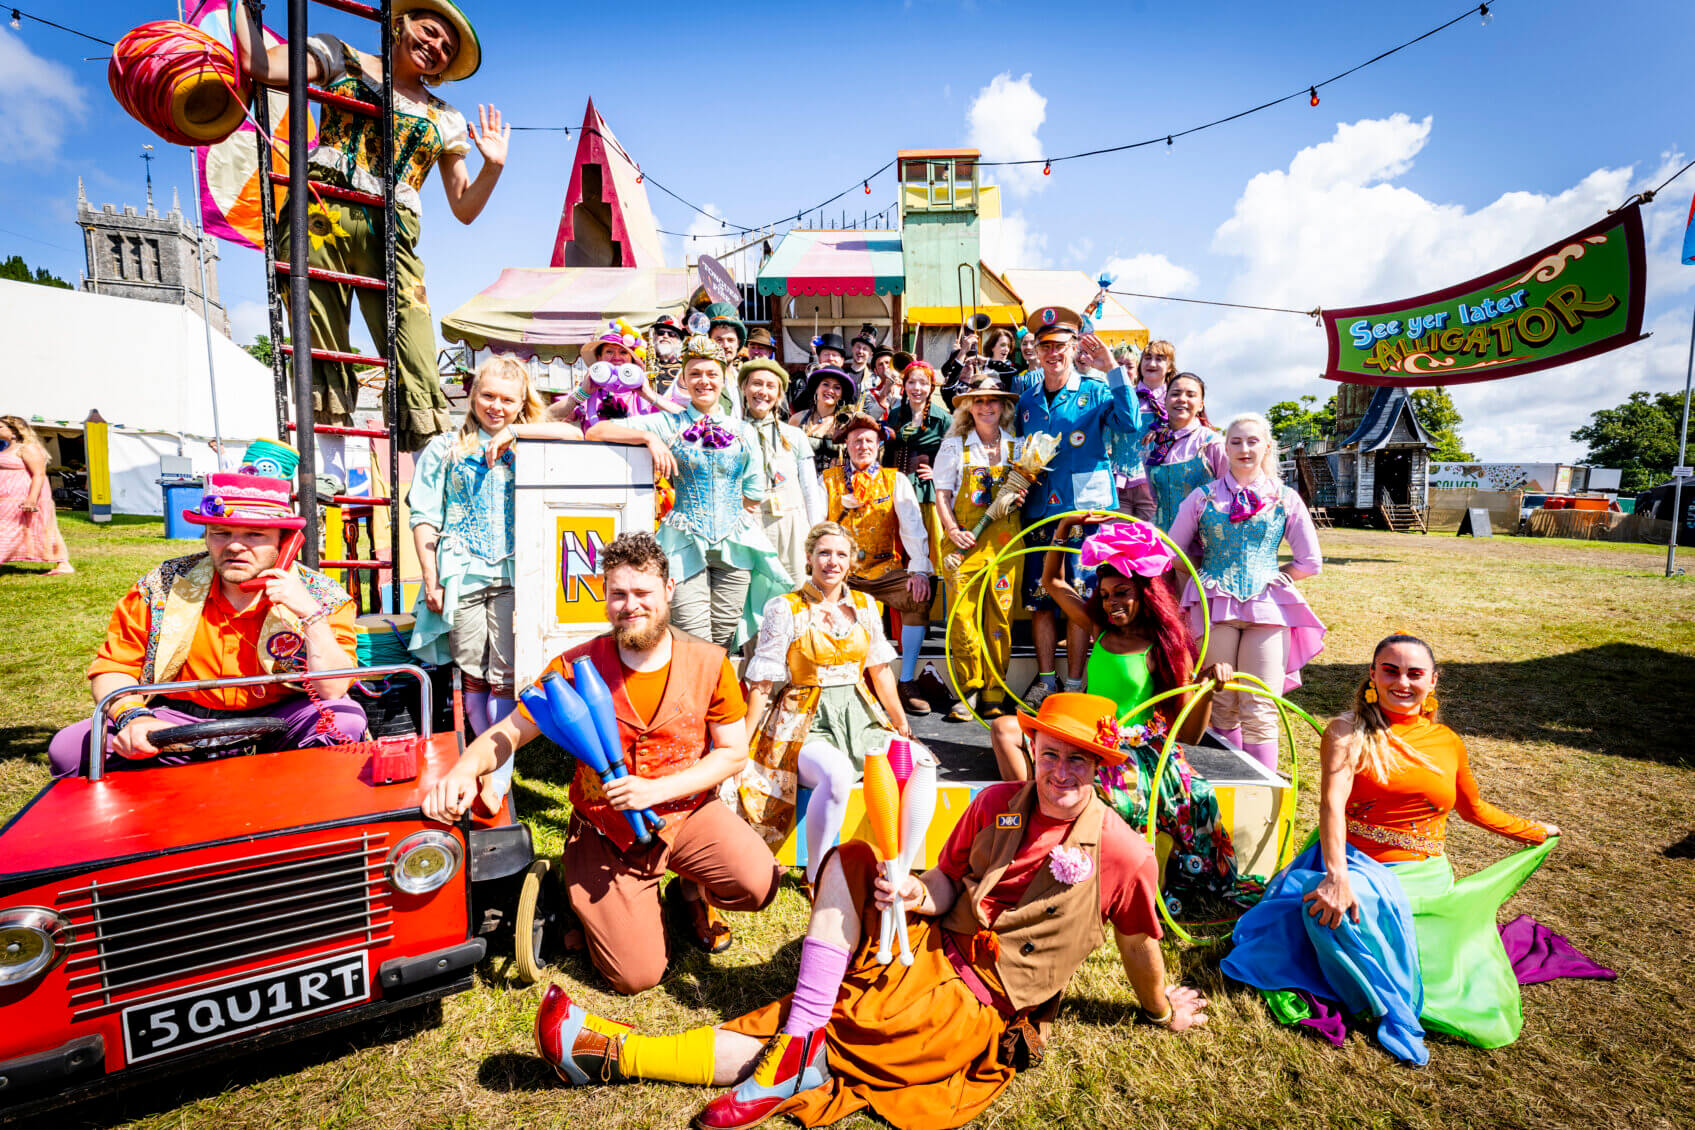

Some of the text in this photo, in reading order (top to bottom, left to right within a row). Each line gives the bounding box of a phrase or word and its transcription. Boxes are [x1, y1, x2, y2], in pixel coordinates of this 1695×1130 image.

[1350, 289, 1527, 348] See yer later
[1364, 284, 1616, 372] ALLIGATOR
